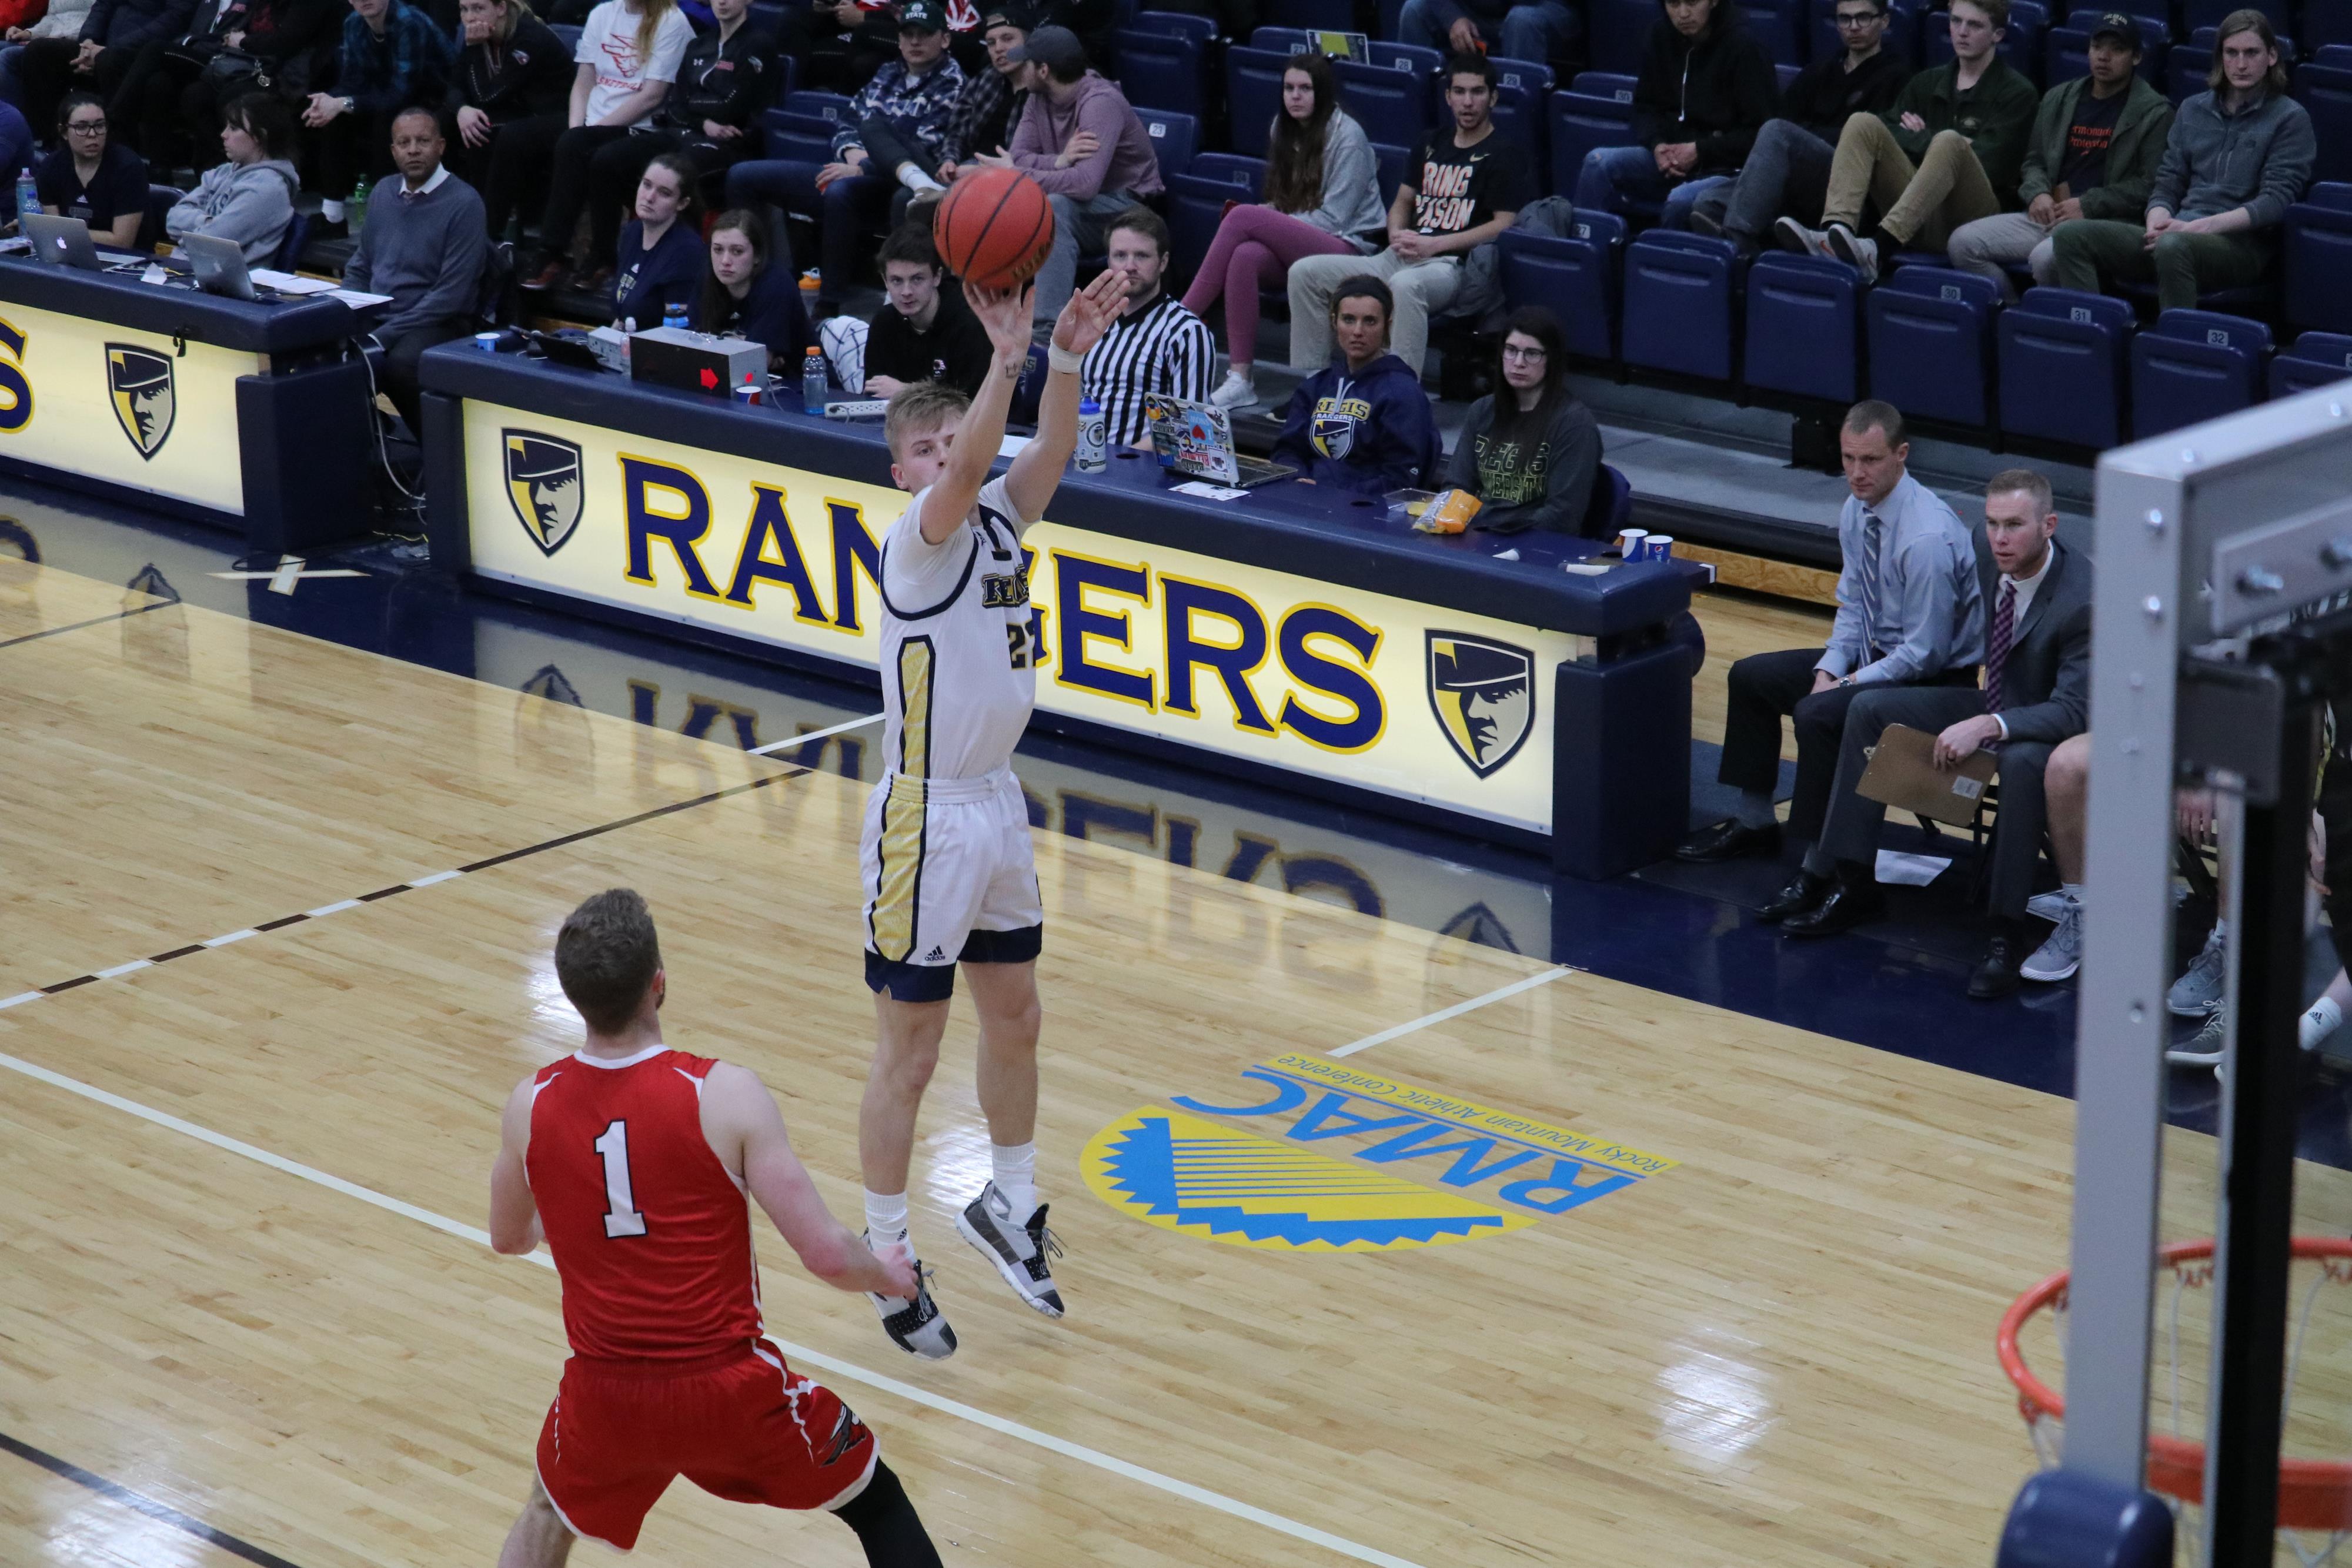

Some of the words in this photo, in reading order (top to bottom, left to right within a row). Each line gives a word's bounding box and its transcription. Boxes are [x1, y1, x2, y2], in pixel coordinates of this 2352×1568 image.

[1294, 45, 1304, 54] 27
[1398, 59, 1409, 71] 28
[1152, 126, 1162, 135] 23
[1421, 162, 1473, 198] RING
[1945, 288, 1956, 299] 30
[2074, 310, 2086, 321] 31
[2212, 332, 2224, 344] 32
[617, 452, 1387, 755] RANERS
[1006, 619, 1036, 670] 2
[1278, 1055, 1398, 1095] Conference
[1398, 1091, 1487, 1119] Athletic
[1170, 1070, 1638, 1215] RMAC
[1485, 1115, 1596, 1152] Mountain
[1595, 1145, 1668, 1172] Rocky
[594, 1119, 647, 1239] 1
